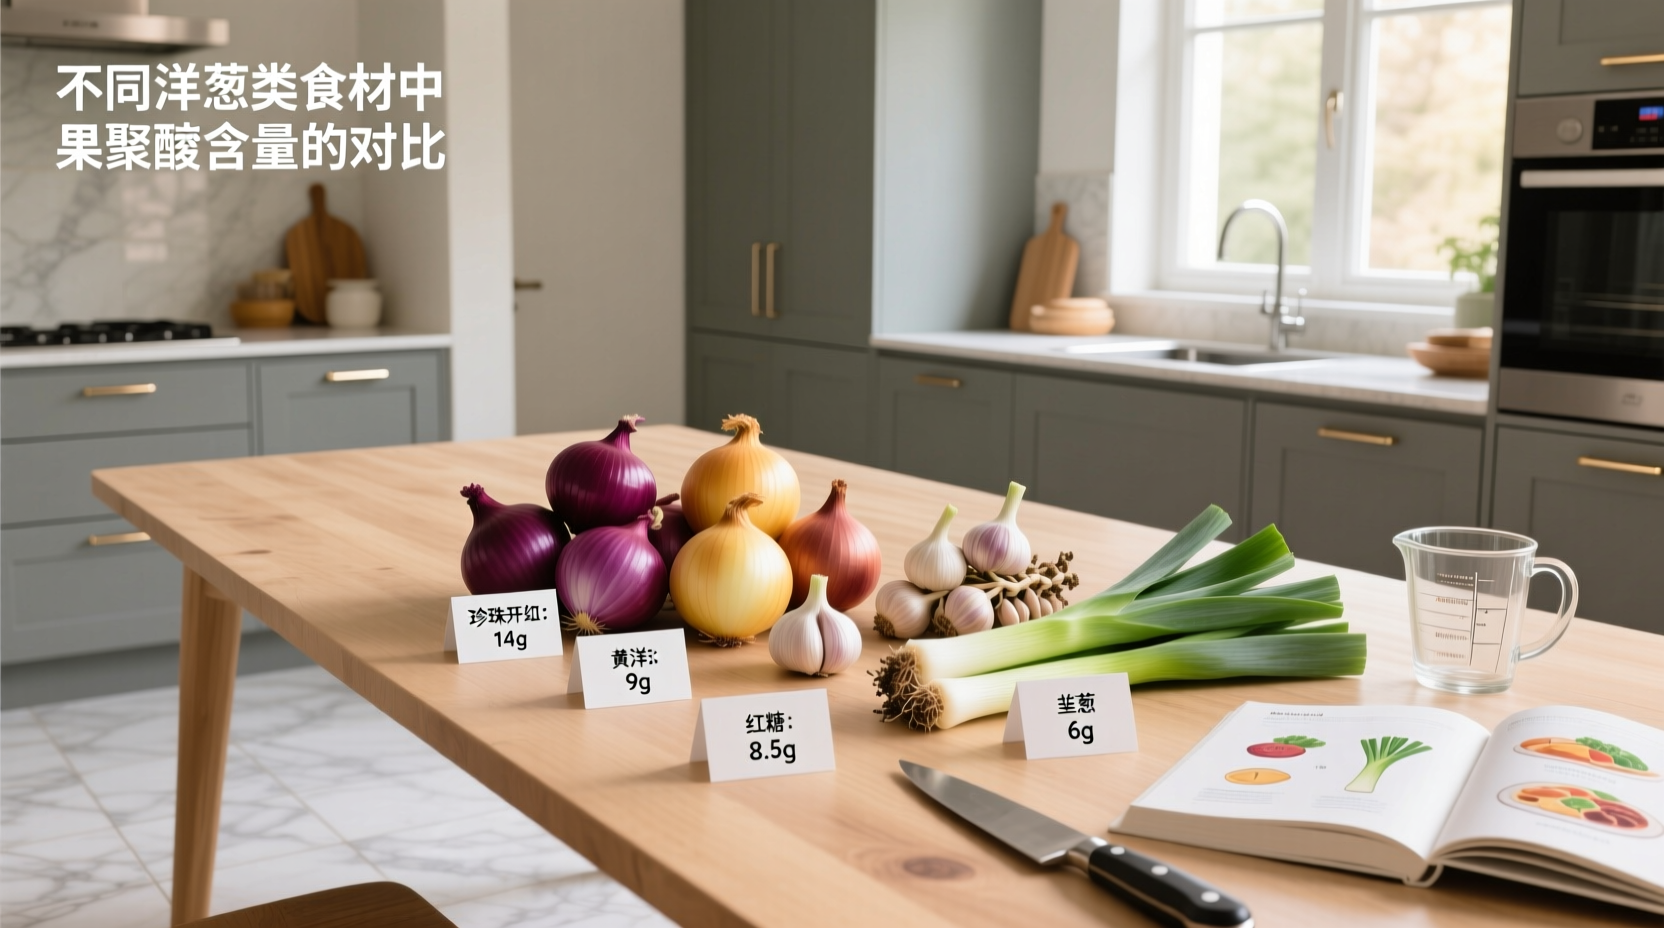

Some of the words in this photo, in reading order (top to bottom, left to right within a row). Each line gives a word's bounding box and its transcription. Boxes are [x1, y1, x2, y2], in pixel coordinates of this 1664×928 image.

[493, 630, 527, 651] 14g
[625, 672, 651, 695] 9g
[1067, 720, 1094, 745] 6g
[749, 738, 796, 764] 8.5g
